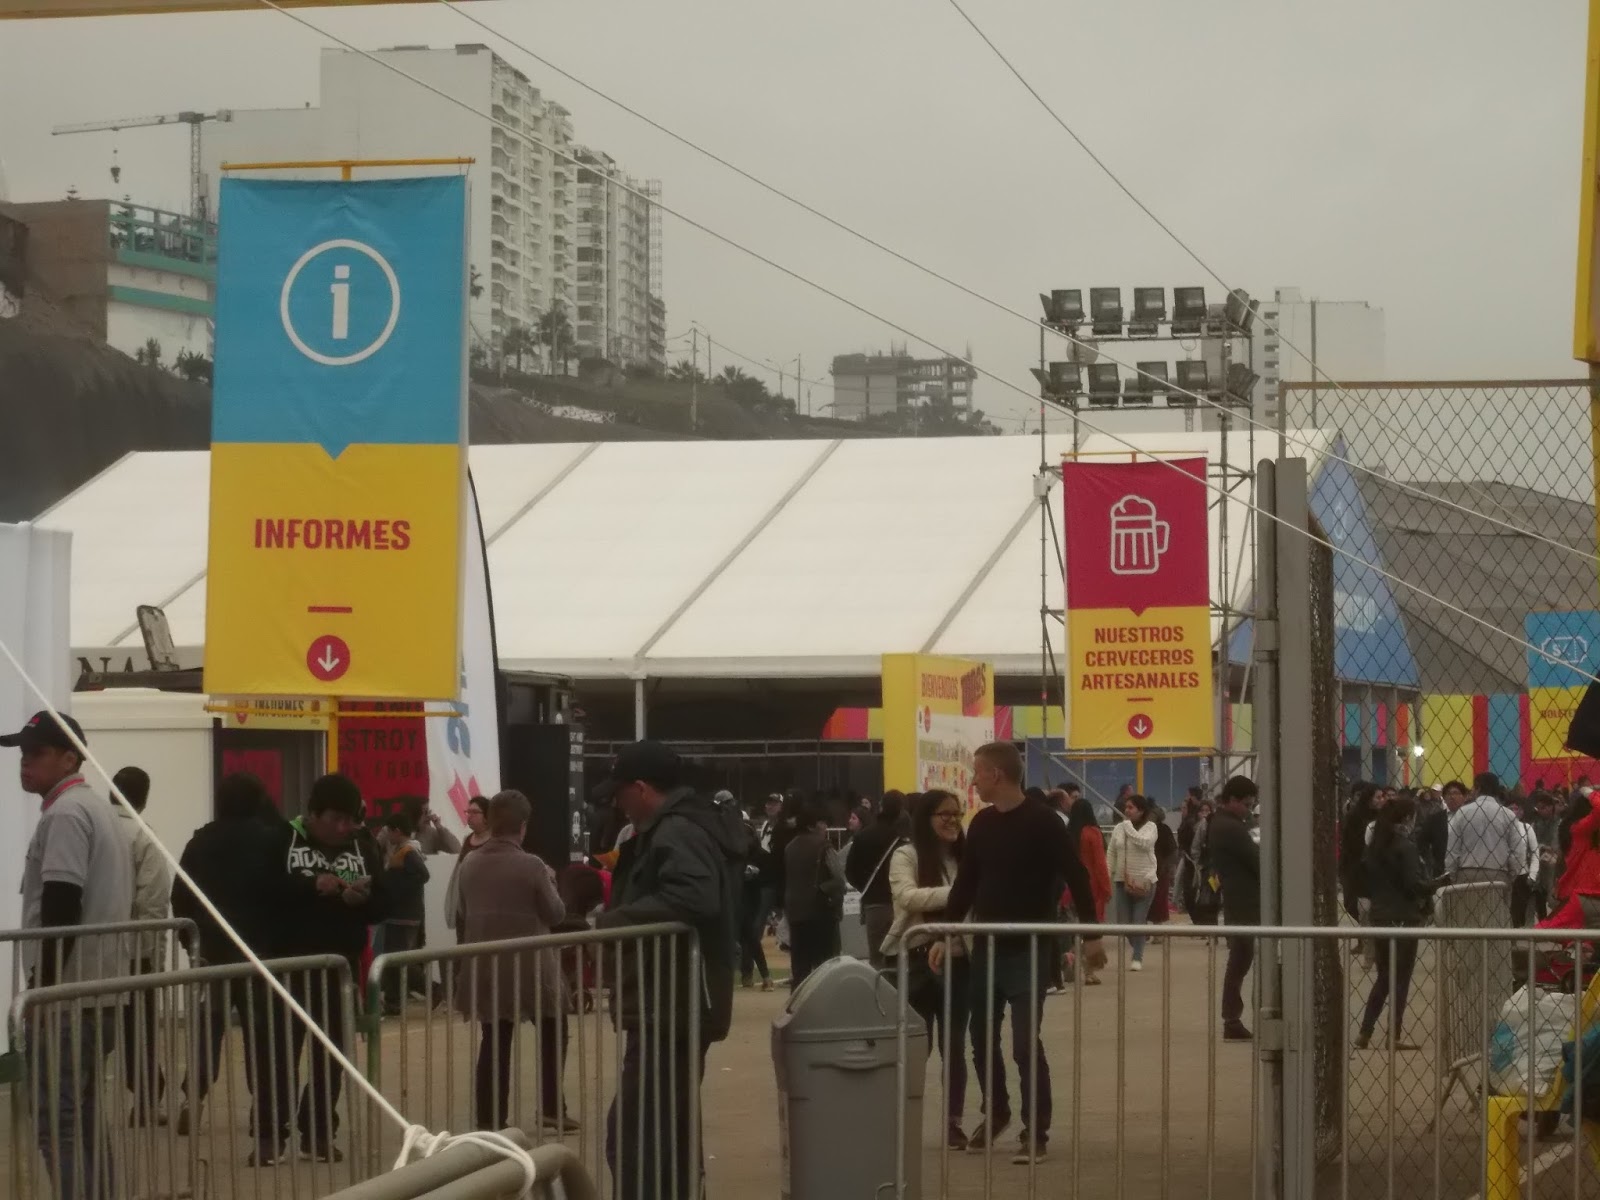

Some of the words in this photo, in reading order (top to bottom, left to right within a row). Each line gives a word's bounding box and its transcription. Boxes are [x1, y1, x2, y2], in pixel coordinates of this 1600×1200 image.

[255, 518, 411, 550] INFORMES
[1095, 626, 1184, 644] NUESTROS
[1085, 649, 1194, 667] CERVECEROS
[1081, 672, 1200, 690] ARTESANALES
